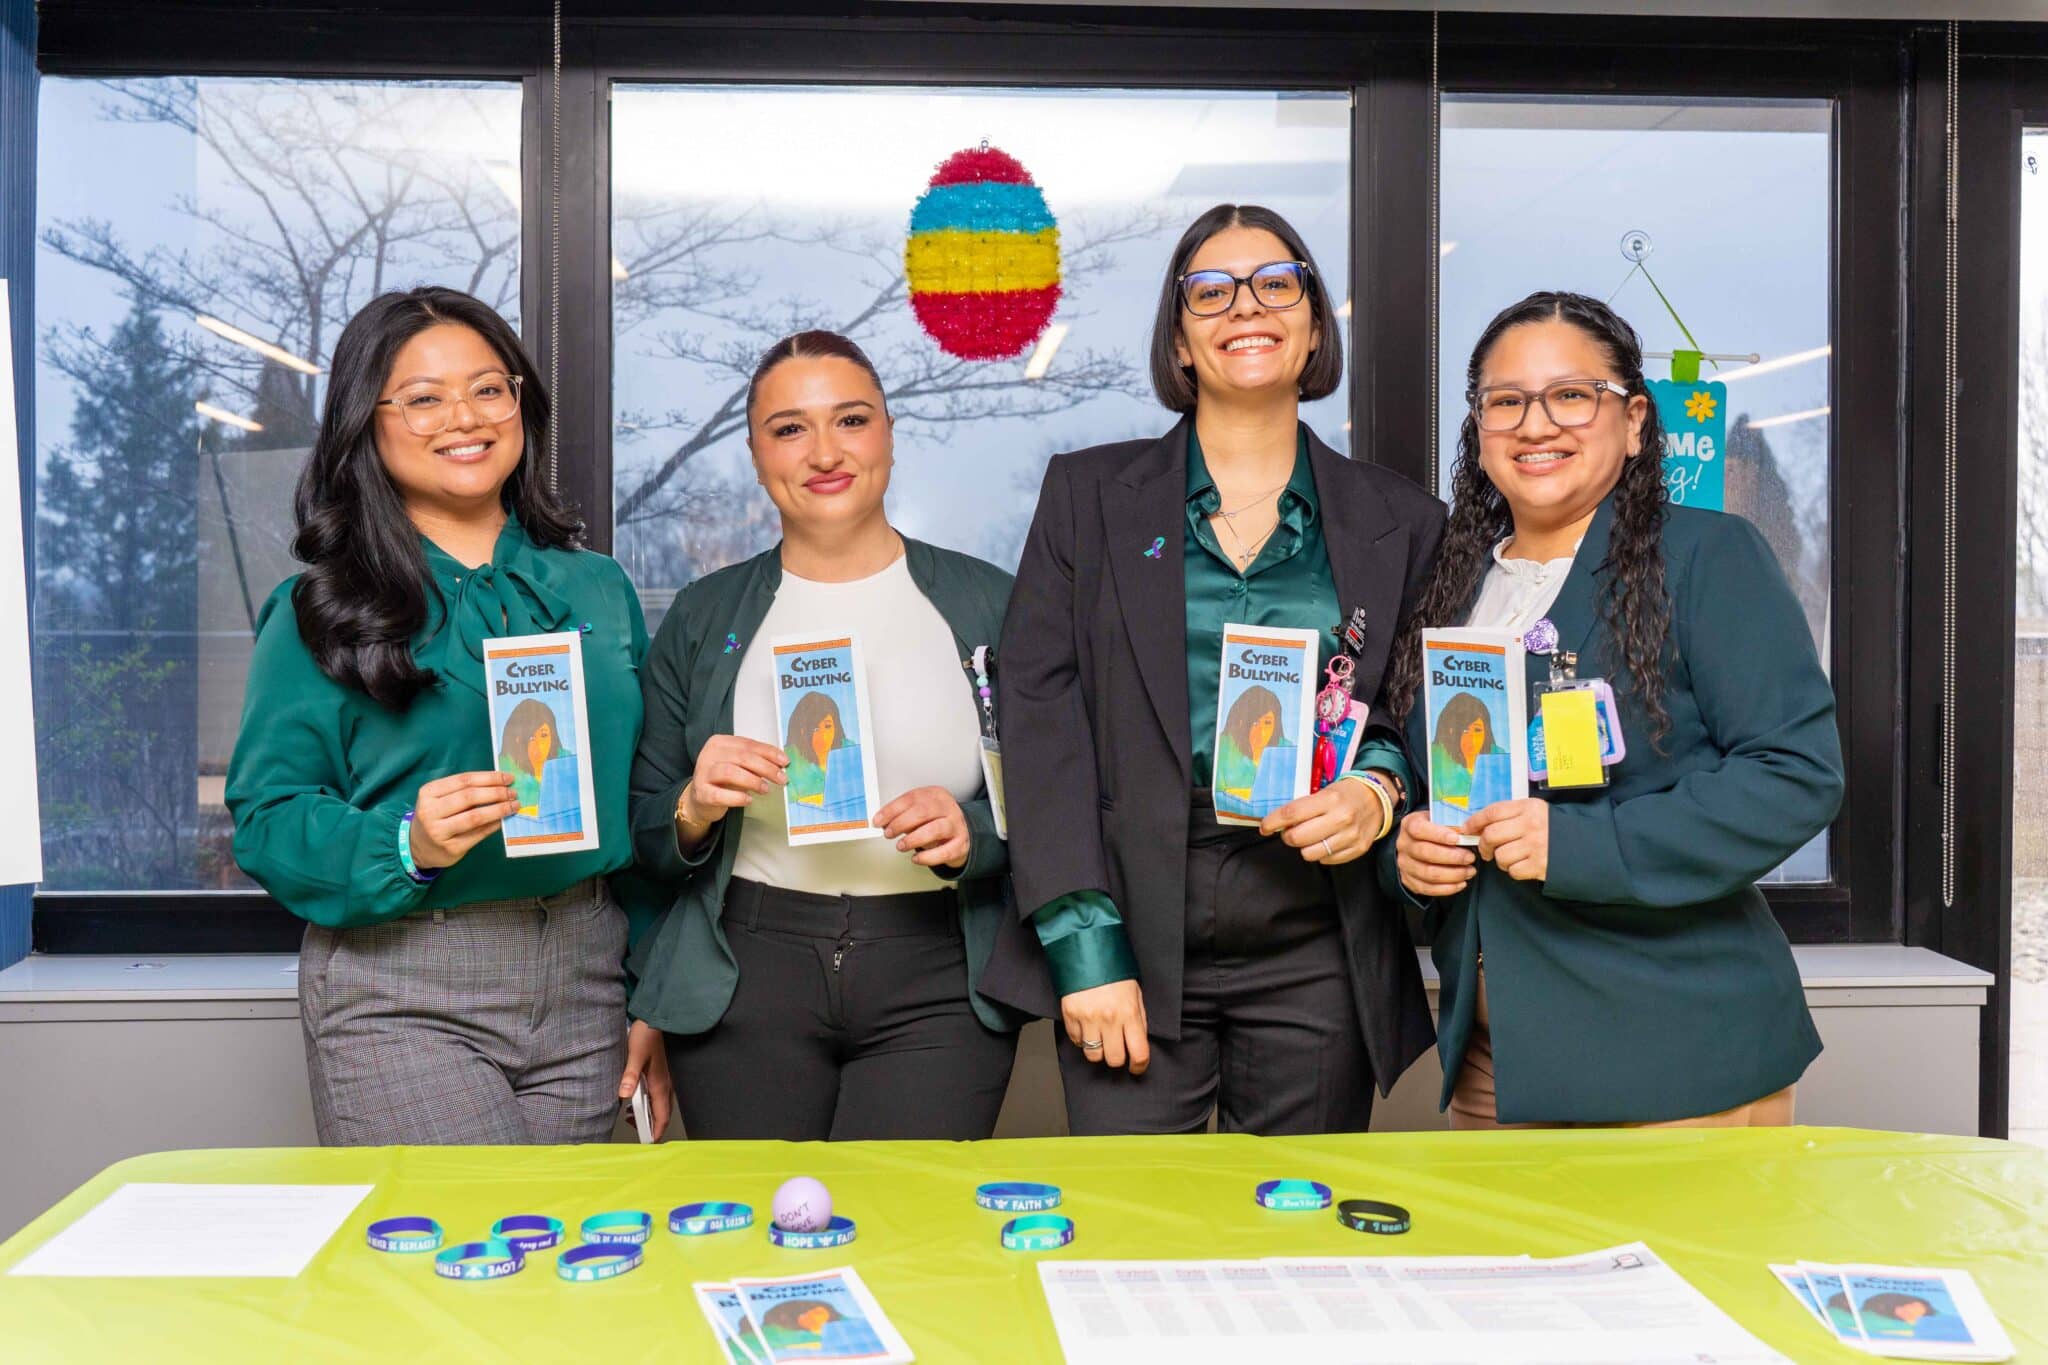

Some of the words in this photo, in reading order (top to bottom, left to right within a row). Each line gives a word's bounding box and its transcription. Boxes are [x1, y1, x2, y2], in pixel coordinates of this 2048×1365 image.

[791, 656, 838, 672] CYBER
[1241, 649, 1289, 667] CYBER
[1443, 655, 1491, 673] CYBER
[506, 662, 555, 678] CYBER
[1228, 663, 1300, 684] BULLYING
[496, 679, 569, 696] BULLYING
[781, 671, 852, 690] BULLYING
[1432, 670, 1505, 691] BULLYING
[1012, 1199, 1042, 1211] FAITH
[783, 1236, 814, 1249] HOPE
[488, 1261, 516, 1276] LOVE
